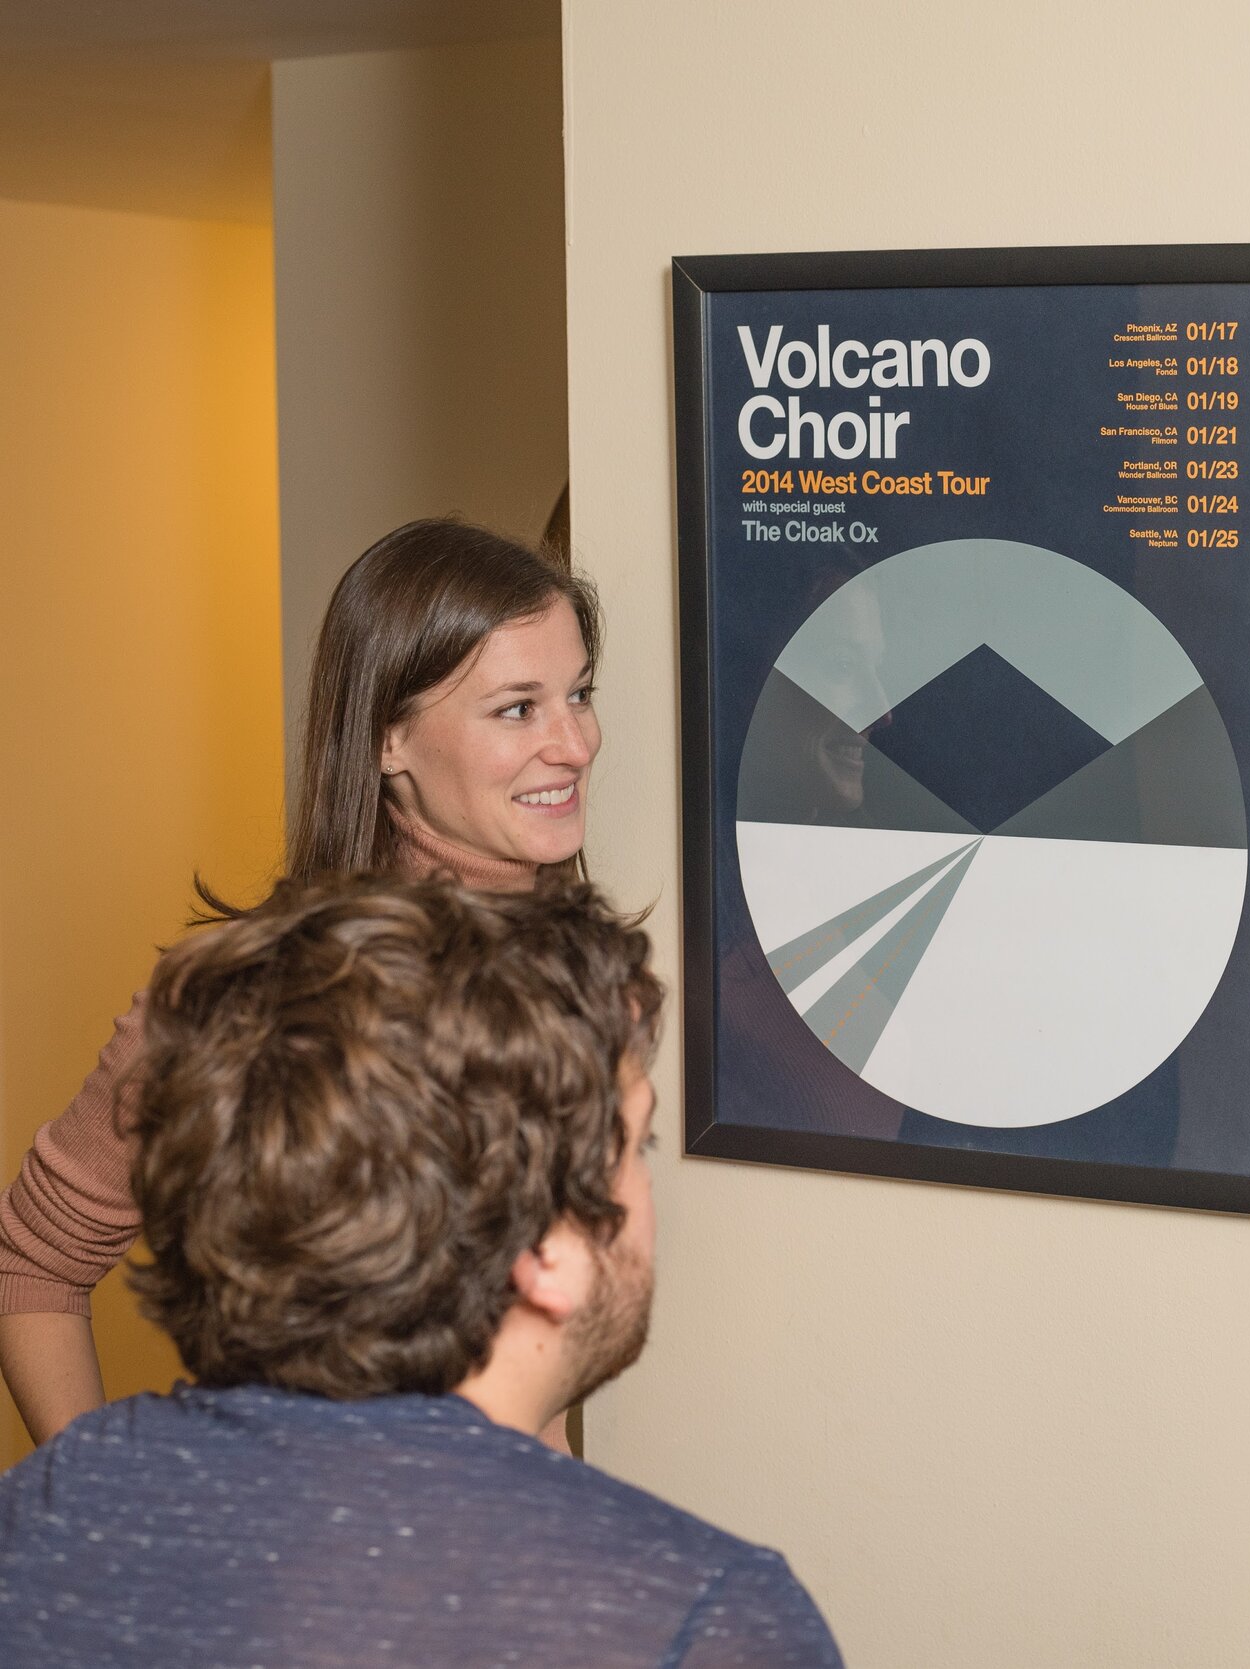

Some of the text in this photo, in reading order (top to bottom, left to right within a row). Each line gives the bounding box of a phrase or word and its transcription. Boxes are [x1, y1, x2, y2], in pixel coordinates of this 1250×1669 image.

[1127, 323, 1177, 333] Phoenix, AZ
[1186, 322, 1238, 341] 01/17
[1114, 334, 1145, 342] Crescent
[737, 324, 991, 389] Volcano
[1109, 359, 1177, 368] Los Angeles, CA
[1186, 357, 1239, 376] 01/18
[1117, 393, 1178, 403] San Diego, CA
[1187, 392, 1239, 410] 01/19
[738, 395, 910, 460] Choir
[1101, 427, 1177, 437] San Francisco, CA
[1187, 426, 1237, 445] 01/21
[1124, 461, 1177, 471] Portland, OR
[1186, 460, 1239, 479] 01/23
[742, 470, 990, 495] 2014 West Coast Tour
[743, 501, 845, 515] with special guest
[1117, 496, 1178, 505] Vancouver, BC
[1187, 495, 1238, 514] 01/24
[742, 520, 878, 543] The Cloak Ox
[1130, 530, 1178, 539] Seattle, WA
[1187, 529, 1239, 548] 01/25
[1149, 540, 1178, 548] Neptune
